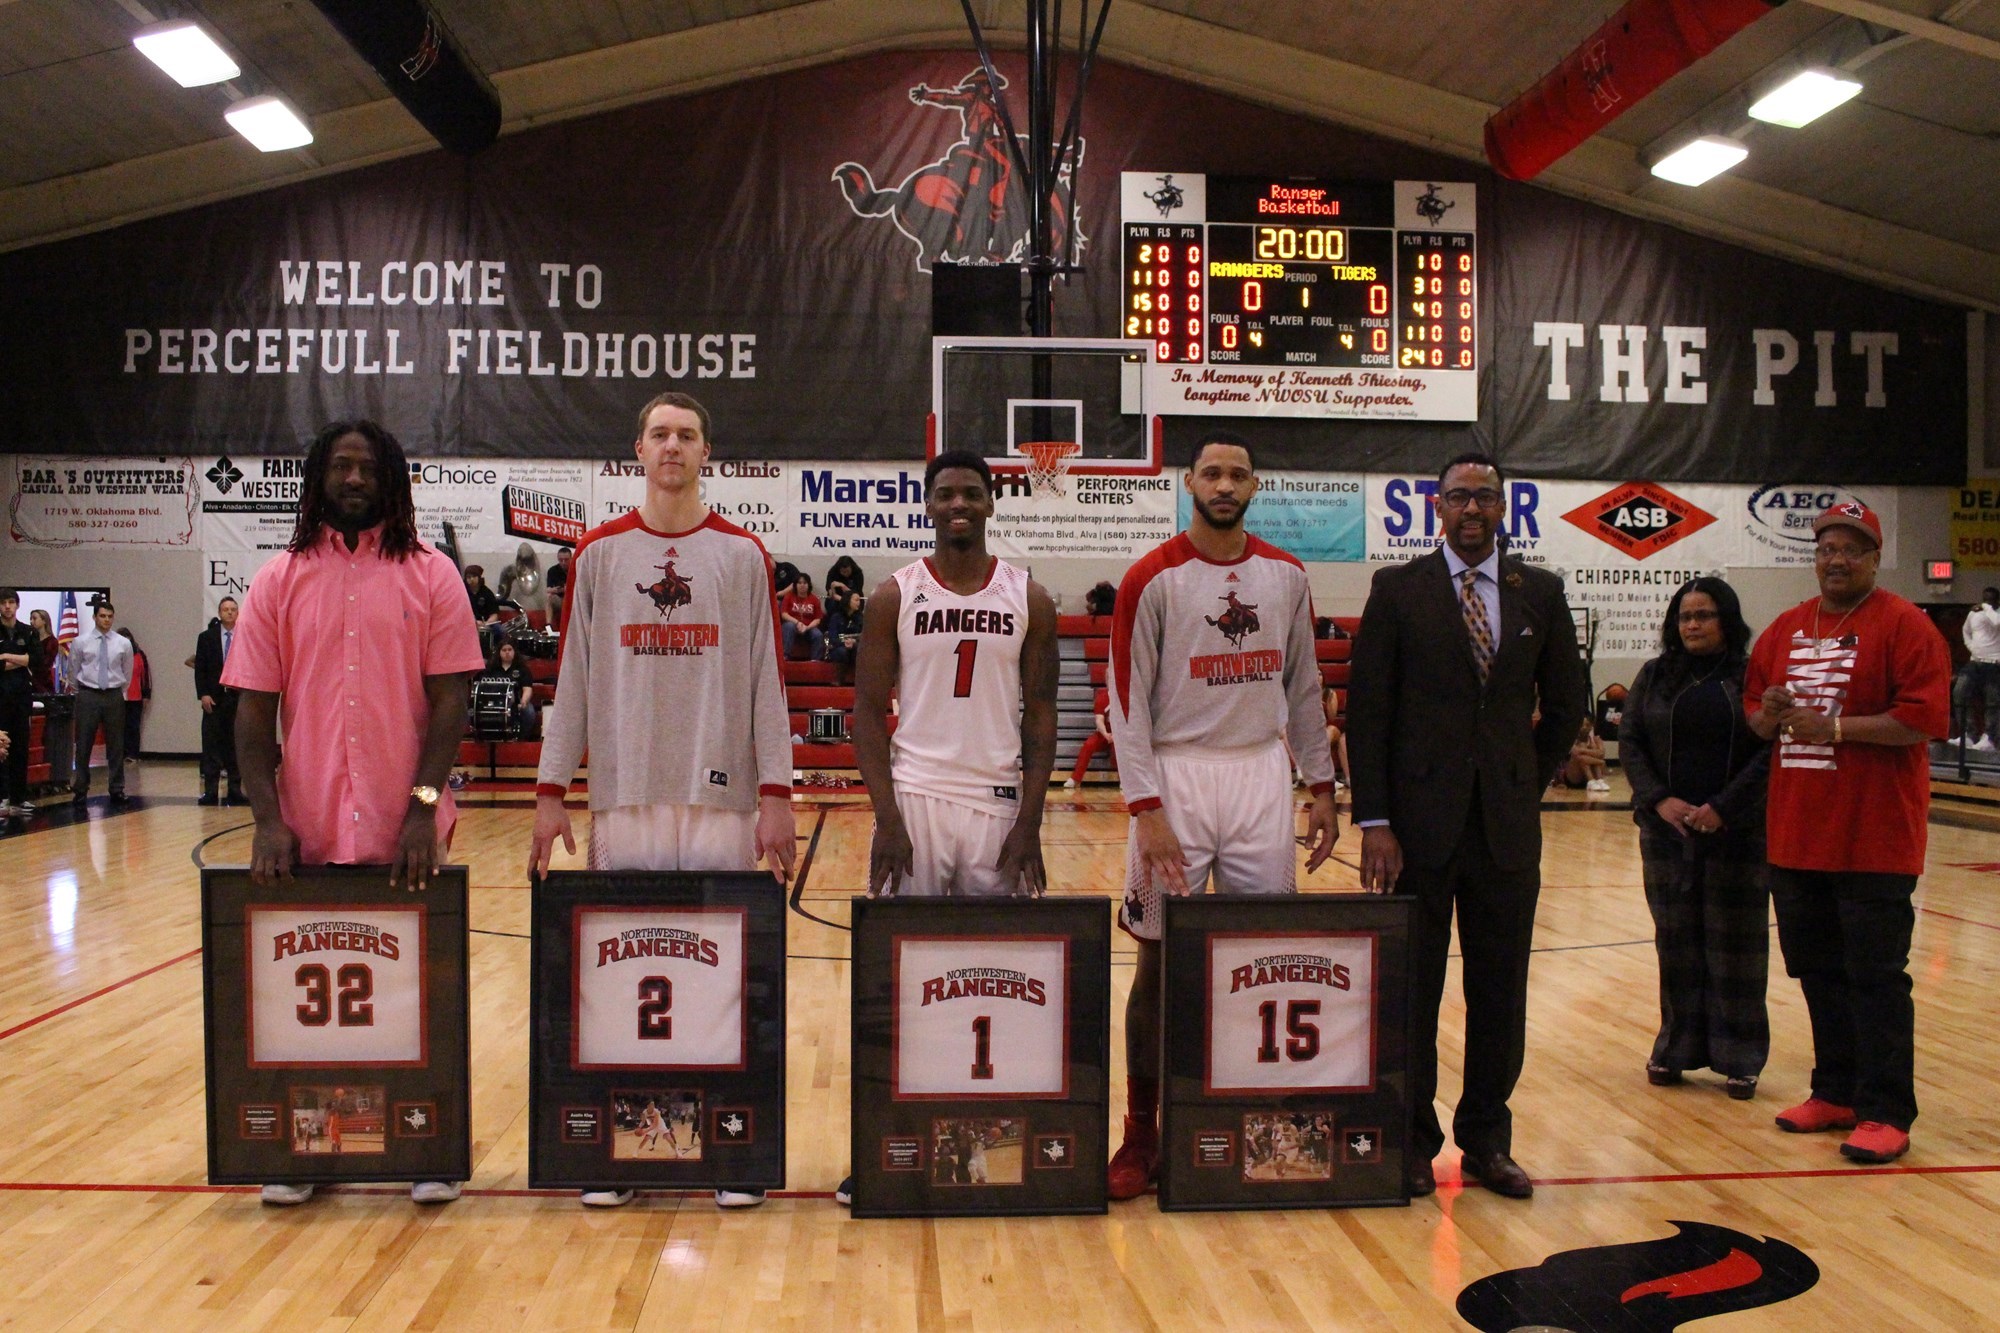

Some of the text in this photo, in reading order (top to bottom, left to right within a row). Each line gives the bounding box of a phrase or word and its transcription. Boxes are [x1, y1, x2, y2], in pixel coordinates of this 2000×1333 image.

[1271, 185, 1326, 201] Ranger
[1259, 199, 1339, 215] Basketball
[1130, 228, 1195, 238] PLYR FLS PTS
[1259, 228, 1344, 260] 20:00
[1403, 236, 1465, 247] PLYR FLS PTS
[1140, 245, 1169, 263] 2 0
[1418, 255, 1424, 269] 1
[1210, 262, 1284, 278] RANGERS
[1285, 272, 1317, 283] PERIOD
[1332, 266, 1376, 281] TIGERS
[280, 260, 602, 308] WELCOME TO
[1159, 270, 1169, 287] 0
[1414, 277, 1424, 295] 3
[1133, 293, 1169, 311] 15 0
[1244, 282, 1261, 311] 0
[1302, 288, 1309, 308] 1
[1370, 285, 1387, 314] 0
[1413, 302, 1424, 317] 4
[1127, 317, 1169, 335] 21 0
[1211, 314, 1240, 324] FOULS
[1270, 316, 1334, 327] PLAYER FOUL
[1361, 318, 1389, 328] FOULS
[1223, 325, 1237, 348] 0
[1249, 332, 1262, 347] 4
[1341, 334, 1353, 349] 4
[1373, 329, 1386, 351] 0
[124, 328, 756, 379] PERCEFULL FIELDHOUSE
[1159, 342, 1169, 359] 0
[1211, 351, 1240, 361] SCORE
[1286, 352, 1317, 363] MATCH
[1401, 348, 1424, 366] 24
[1361, 354, 1390, 364] SCORE
[1533, 321, 1898, 408] THE PIT
[1172, 369, 1427, 391] In Memory of Kenneth Thiesing,
[1185, 387, 1413, 408] longtime NWOSU Supporter.
[22, 470, 56, 483] BAR
[84, 470, 184, 483] OUTFITTERS
[423, 465, 496, 484] Choice
[600, 460, 780, 478] Alva Clinic
[22, 485, 184, 495] CASUAL AND WESTERN WEAR
[242, 482, 304, 498] WESTER
[802, 471, 924, 503] Marsh
[1077, 478, 1171, 491] PERFORMANCE
[1281, 479, 1359, 492] Insurance
[511, 487, 583, 521] SCHUESSLER
[1077, 492, 1133, 505] CENTERS
[1262, 498, 1348, 507] insurance needs
[1601, 490, 1635, 510] IN ALVA
[1642, 488, 1668, 505] SINCE
[1765, 492, 1836, 509] AEC
[738, 502, 773, 515] O.D.
[1384, 479, 1540, 538] STR
[514, 512, 583, 539] REAL ESTATE
[801, 513, 899, 528] FUNERAL
[996, 514, 1020, 524] Uniting
[1021, 514, 1050, 523] hands-on
[1052, 515, 1076, 524] physical
[1078, 515, 1102, 525] therapy
[1104, 515, 1115, 523] and
[1117, 515, 1156, 525] personalized
[1286, 519, 1300, 527] OK
[1614, 507, 1668, 528] ASB
[1784, 513, 1817, 528] Serv
[744, 521, 779, 532] O.D.
[812, 537, 880, 548] Alva and
[988, 530, 1001, 538] 919
[1003, 530, 1012, 538] W.
[1015, 530, 1054, 538] Oklahoma
[1080, 531, 1097, 539] Alva
[1104, 532, 1127, 540] (580)
[1598, 523, 1634, 548] MEMBER
[1653, 528, 1677, 546] FDIC
[1745, 524, 1756, 537] For
[1756, 535, 1768, 545] All
[1769, 540, 1787, 551] Your
[1935, 562, 1951, 578] EXIT
[1581, 593, 1652, 602] Michael Meier
[1607, 609, 1642, 618] Brandon
[914, 609, 1014, 636] RANGERS
[1610, 622, 1637, 631] Dustin
[620, 624, 719, 648] NORTHWESTERN
[634, 647, 703, 656] BASKETBALL
[1602, 640, 1627, 650] (580)
[953, 639, 978, 698] 1
[1207, 672, 1273, 686] BASKETBALL
[297, 921, 379, 936] NORTHWESTERN
[621, 927, 699, 942] NORTHWESTERN
[273, 930, 400, 962] RANGERS
[597, 936, 718, 968] RANGERS
[1254, 954, 1332, 968] NORTHWESTERN
[946, 968, 1026, 982] NORTHWESTERN
[1230, 963, 1350, 993] RANGERS
[295, 963, 374, 1027] 32
[921, 976, 1046, 1007] RANGERS
[638, 975, 672, 1040] 2
[1258, 1000, 1321, 1063] 15
[971, 1016, 994, 1079] 1
